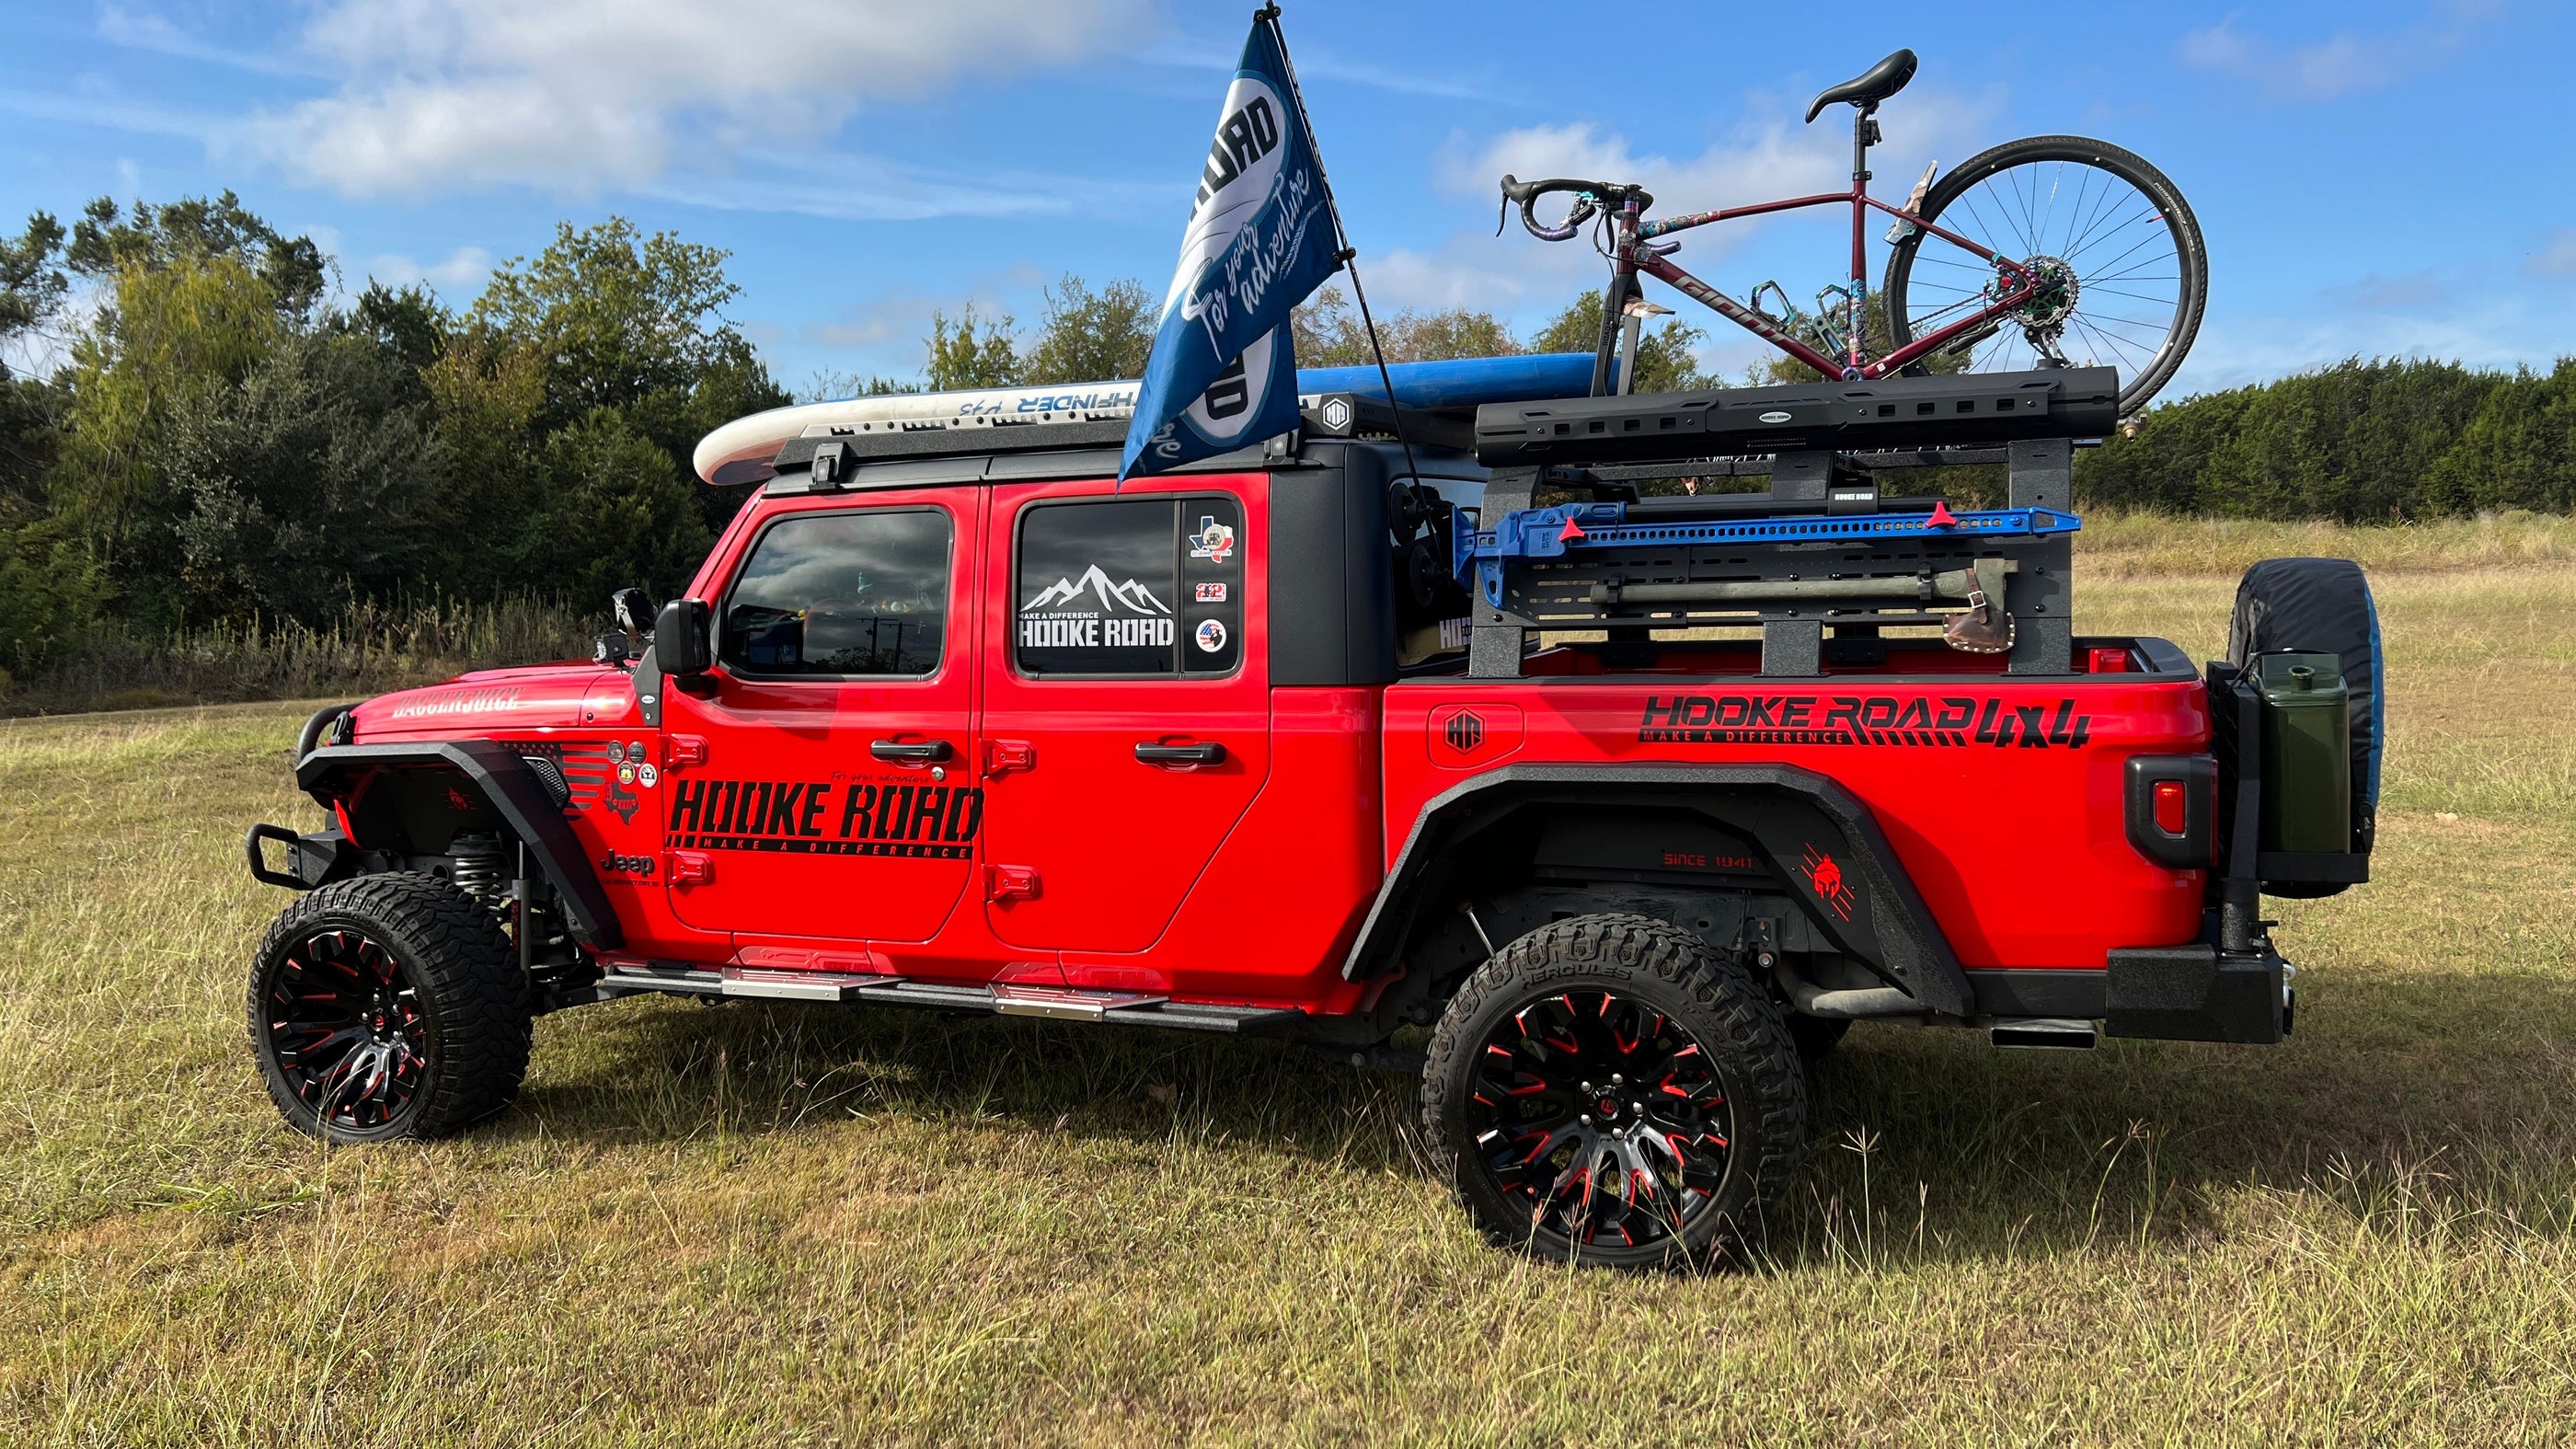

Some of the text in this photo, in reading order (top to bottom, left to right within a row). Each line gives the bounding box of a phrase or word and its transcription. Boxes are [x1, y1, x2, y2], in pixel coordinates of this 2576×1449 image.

[1241, 168, 1310, 315] adventure
[1181, 222, 1259, 363] For your
[1018, 391, 1135, 413] HFINDER
[1834, 492, 1874, 501] HOOKE ROAD
[1041, 612, 1048, 620] A
[1049, 611, 1099, 619] DIFFERENCE
[1018, 618, 1175, 648] HOOKE ROAD
[1641, 696, 1819, 727] HOOKE
[1824, 696, 1977, 746] ROAD
[1643, 730, 1844, 743] MAKE A DIFFERENCE
[669, 780, 985, 843] HOOKE ROAD
[703, 838, 967, 858] MAKE A DIFFERENCE
[1663, 853, 1707, 867] SINCE
[601, 848, 656, 878] Jeep
[1522, 964, 1634, 990] HERCULES
